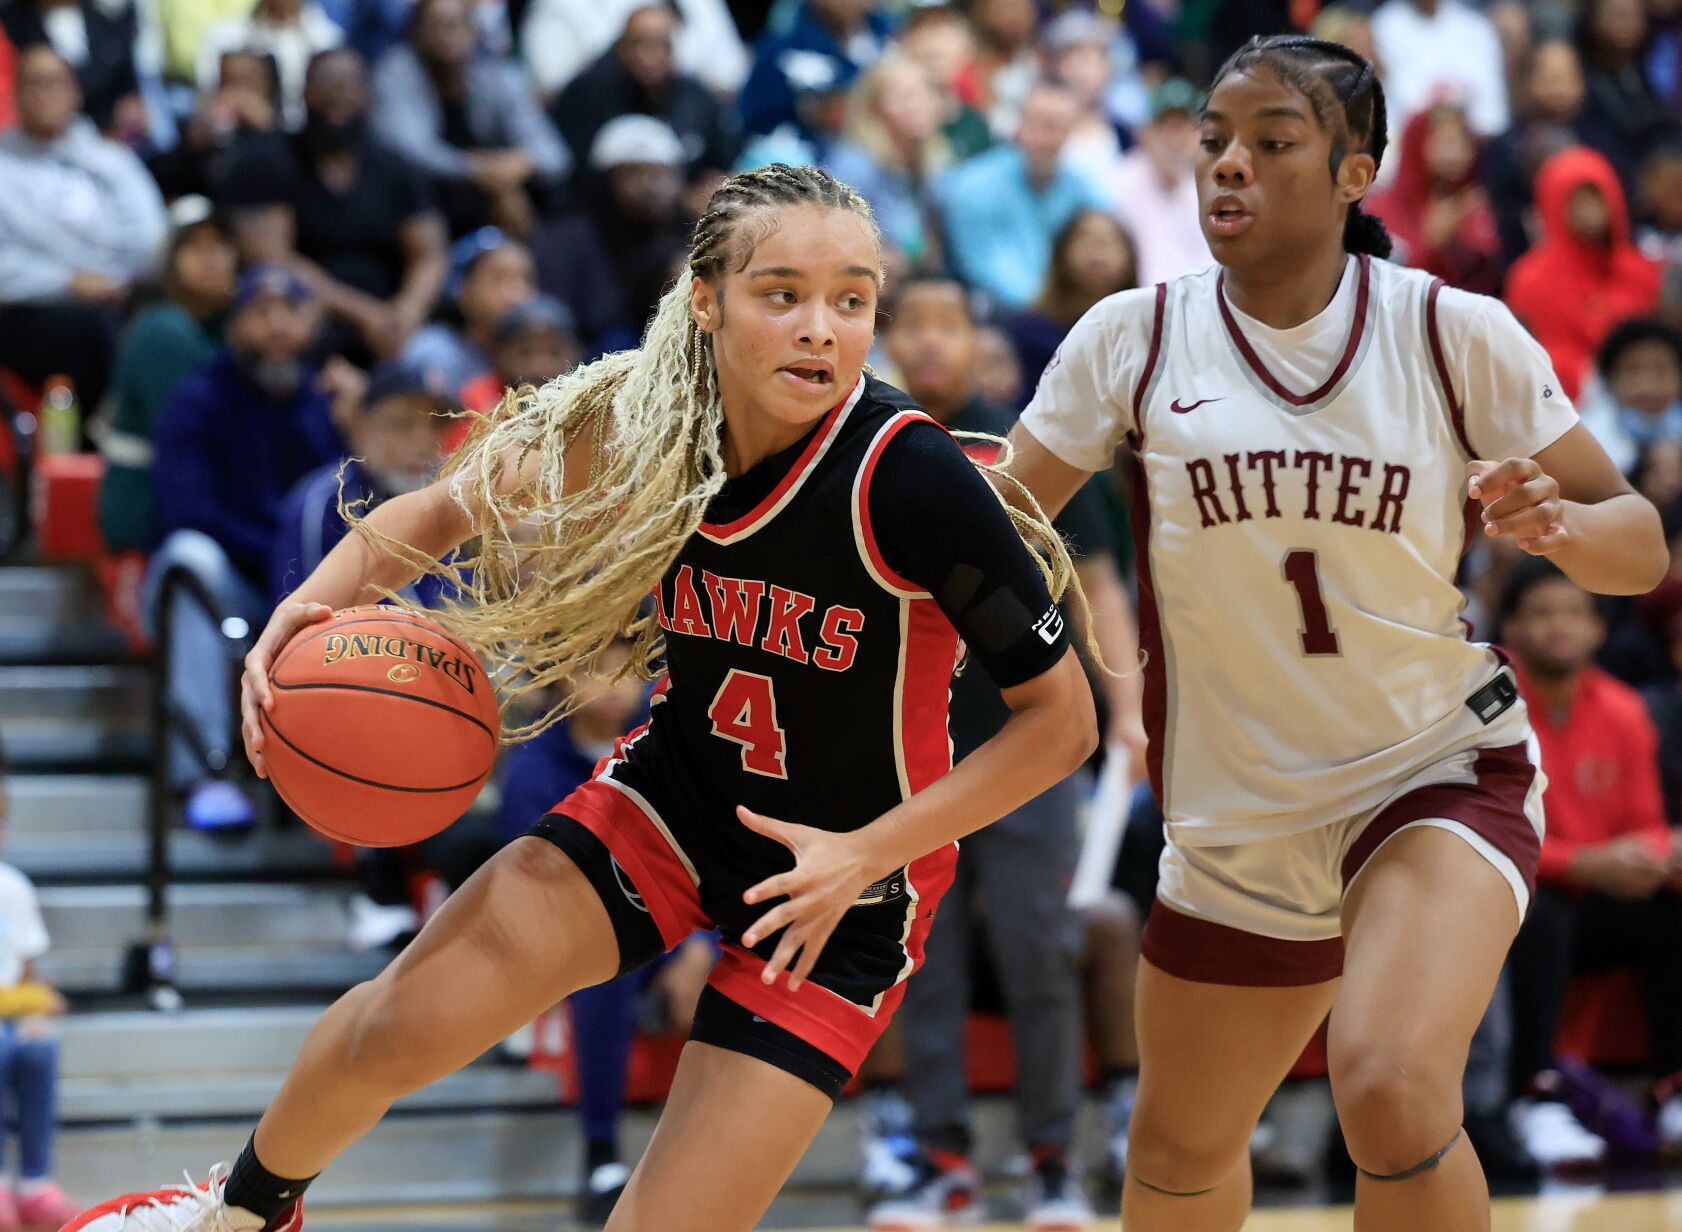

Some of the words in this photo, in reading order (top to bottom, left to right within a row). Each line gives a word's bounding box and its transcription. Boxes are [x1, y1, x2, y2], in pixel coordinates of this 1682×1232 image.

[1185, 450, 1411, 534] RITTER
[1280, 547, 1343, 658] 1
[323, 633, 476, 695] SPALDING
[708, 668, 789, 781] 4
[890, 882, 900, 894] S
